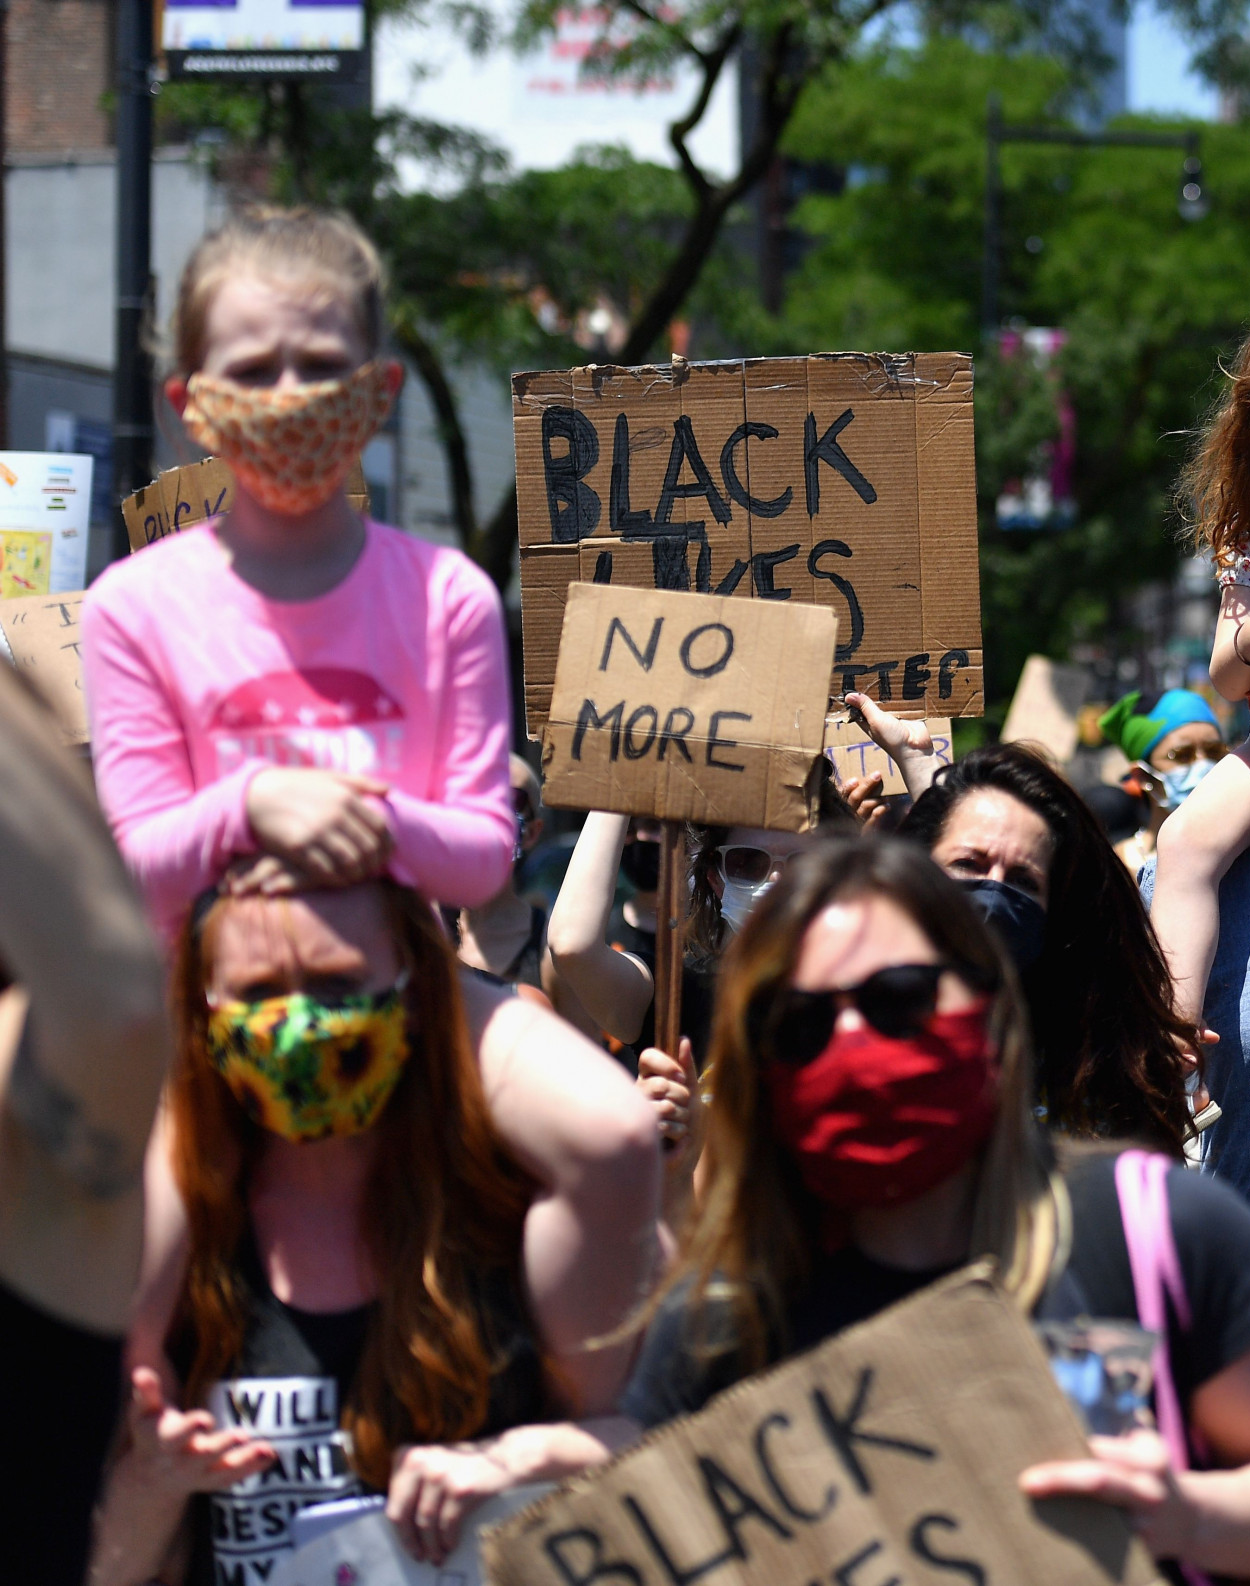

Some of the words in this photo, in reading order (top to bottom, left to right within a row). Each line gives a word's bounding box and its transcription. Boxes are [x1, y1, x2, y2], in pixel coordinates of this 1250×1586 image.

[542, 405, 878, 544] BLACK
[598, 616, 734, 679] NO
[571, 697, 753, 772] MORE
[226, 1388, 330, 1427] WILL
[542, 1366, 938, 1586] BLACK
